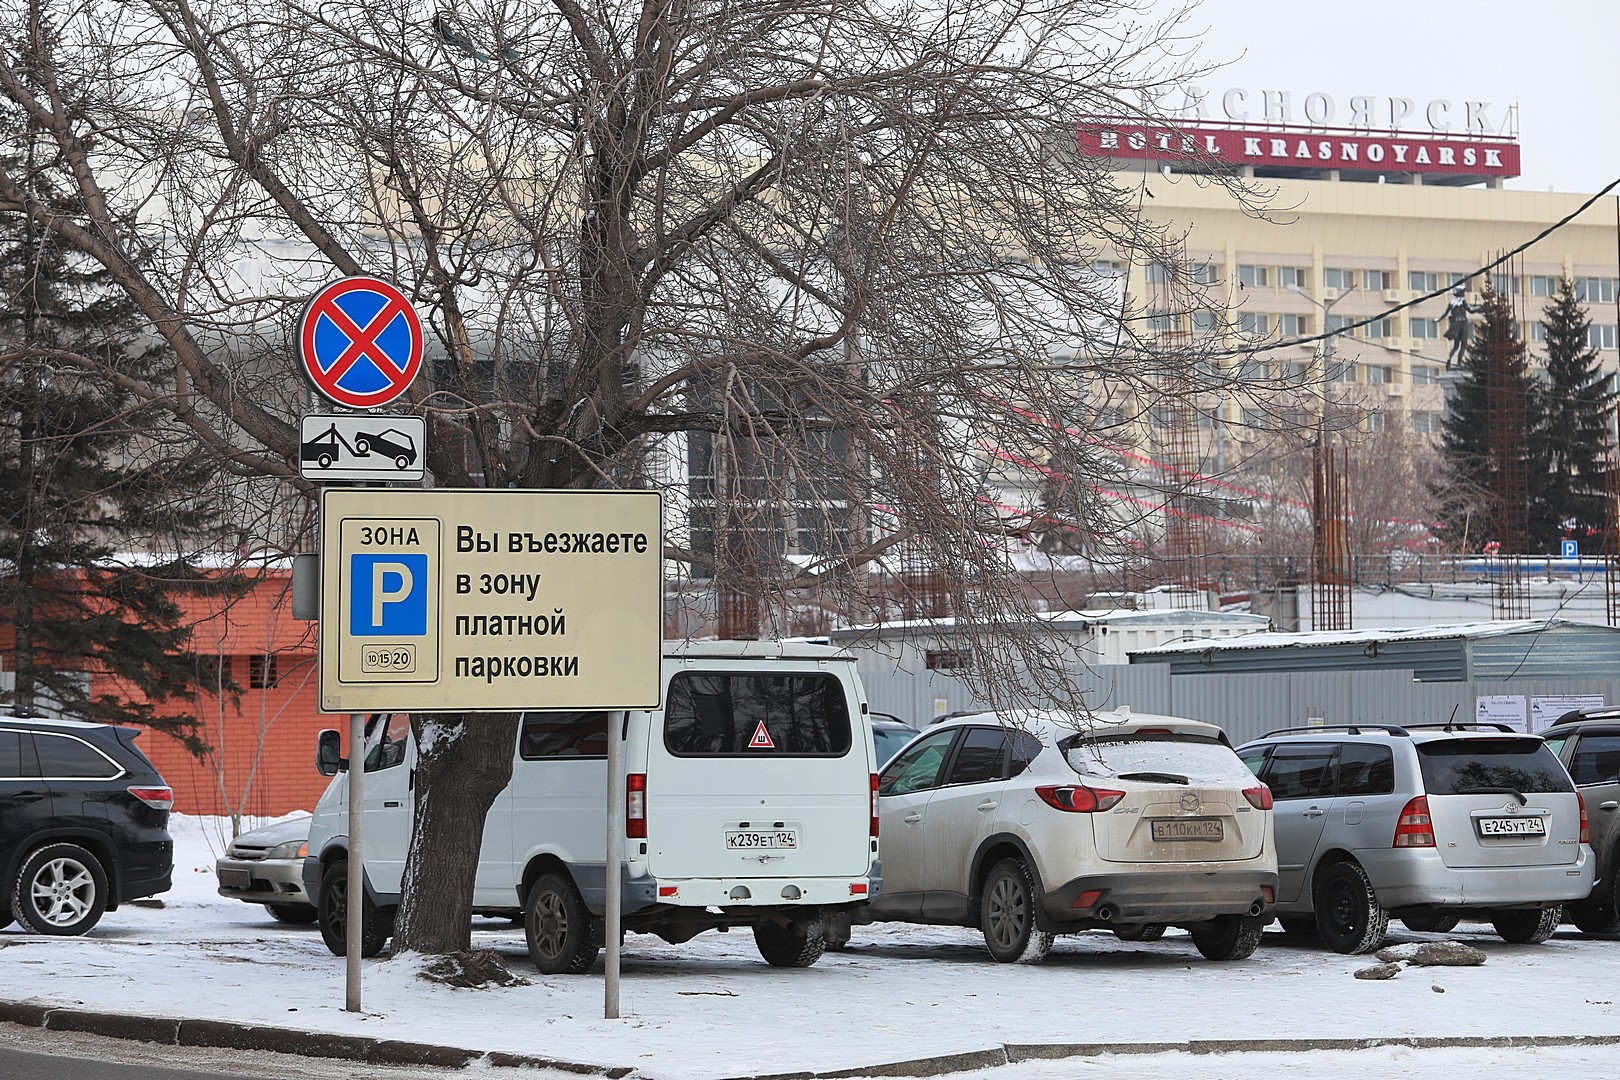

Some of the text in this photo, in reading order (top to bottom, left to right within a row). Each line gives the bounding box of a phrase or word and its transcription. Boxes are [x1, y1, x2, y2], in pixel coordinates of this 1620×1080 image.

[1099, 131, 1504, 168] HOTEL KRASNOYARSK
[360, 526, 420, 546] ЗОНА
[456, 525, 648, 553] Вы въезжаете
[371, 562, 414, 627] P
[456, 574, 541, 601] в зону
[455, 608, 566, 636] платной
[368, 652, 409, 664] 10 15 20
[455, 656, 579, 683] парковки
[1158, 822, 1219, 837] В110КМ 124
[1484, 819, 1539, 833] Е245УТ 24
[731, 833, 793, 847] К239ЕТ 124
